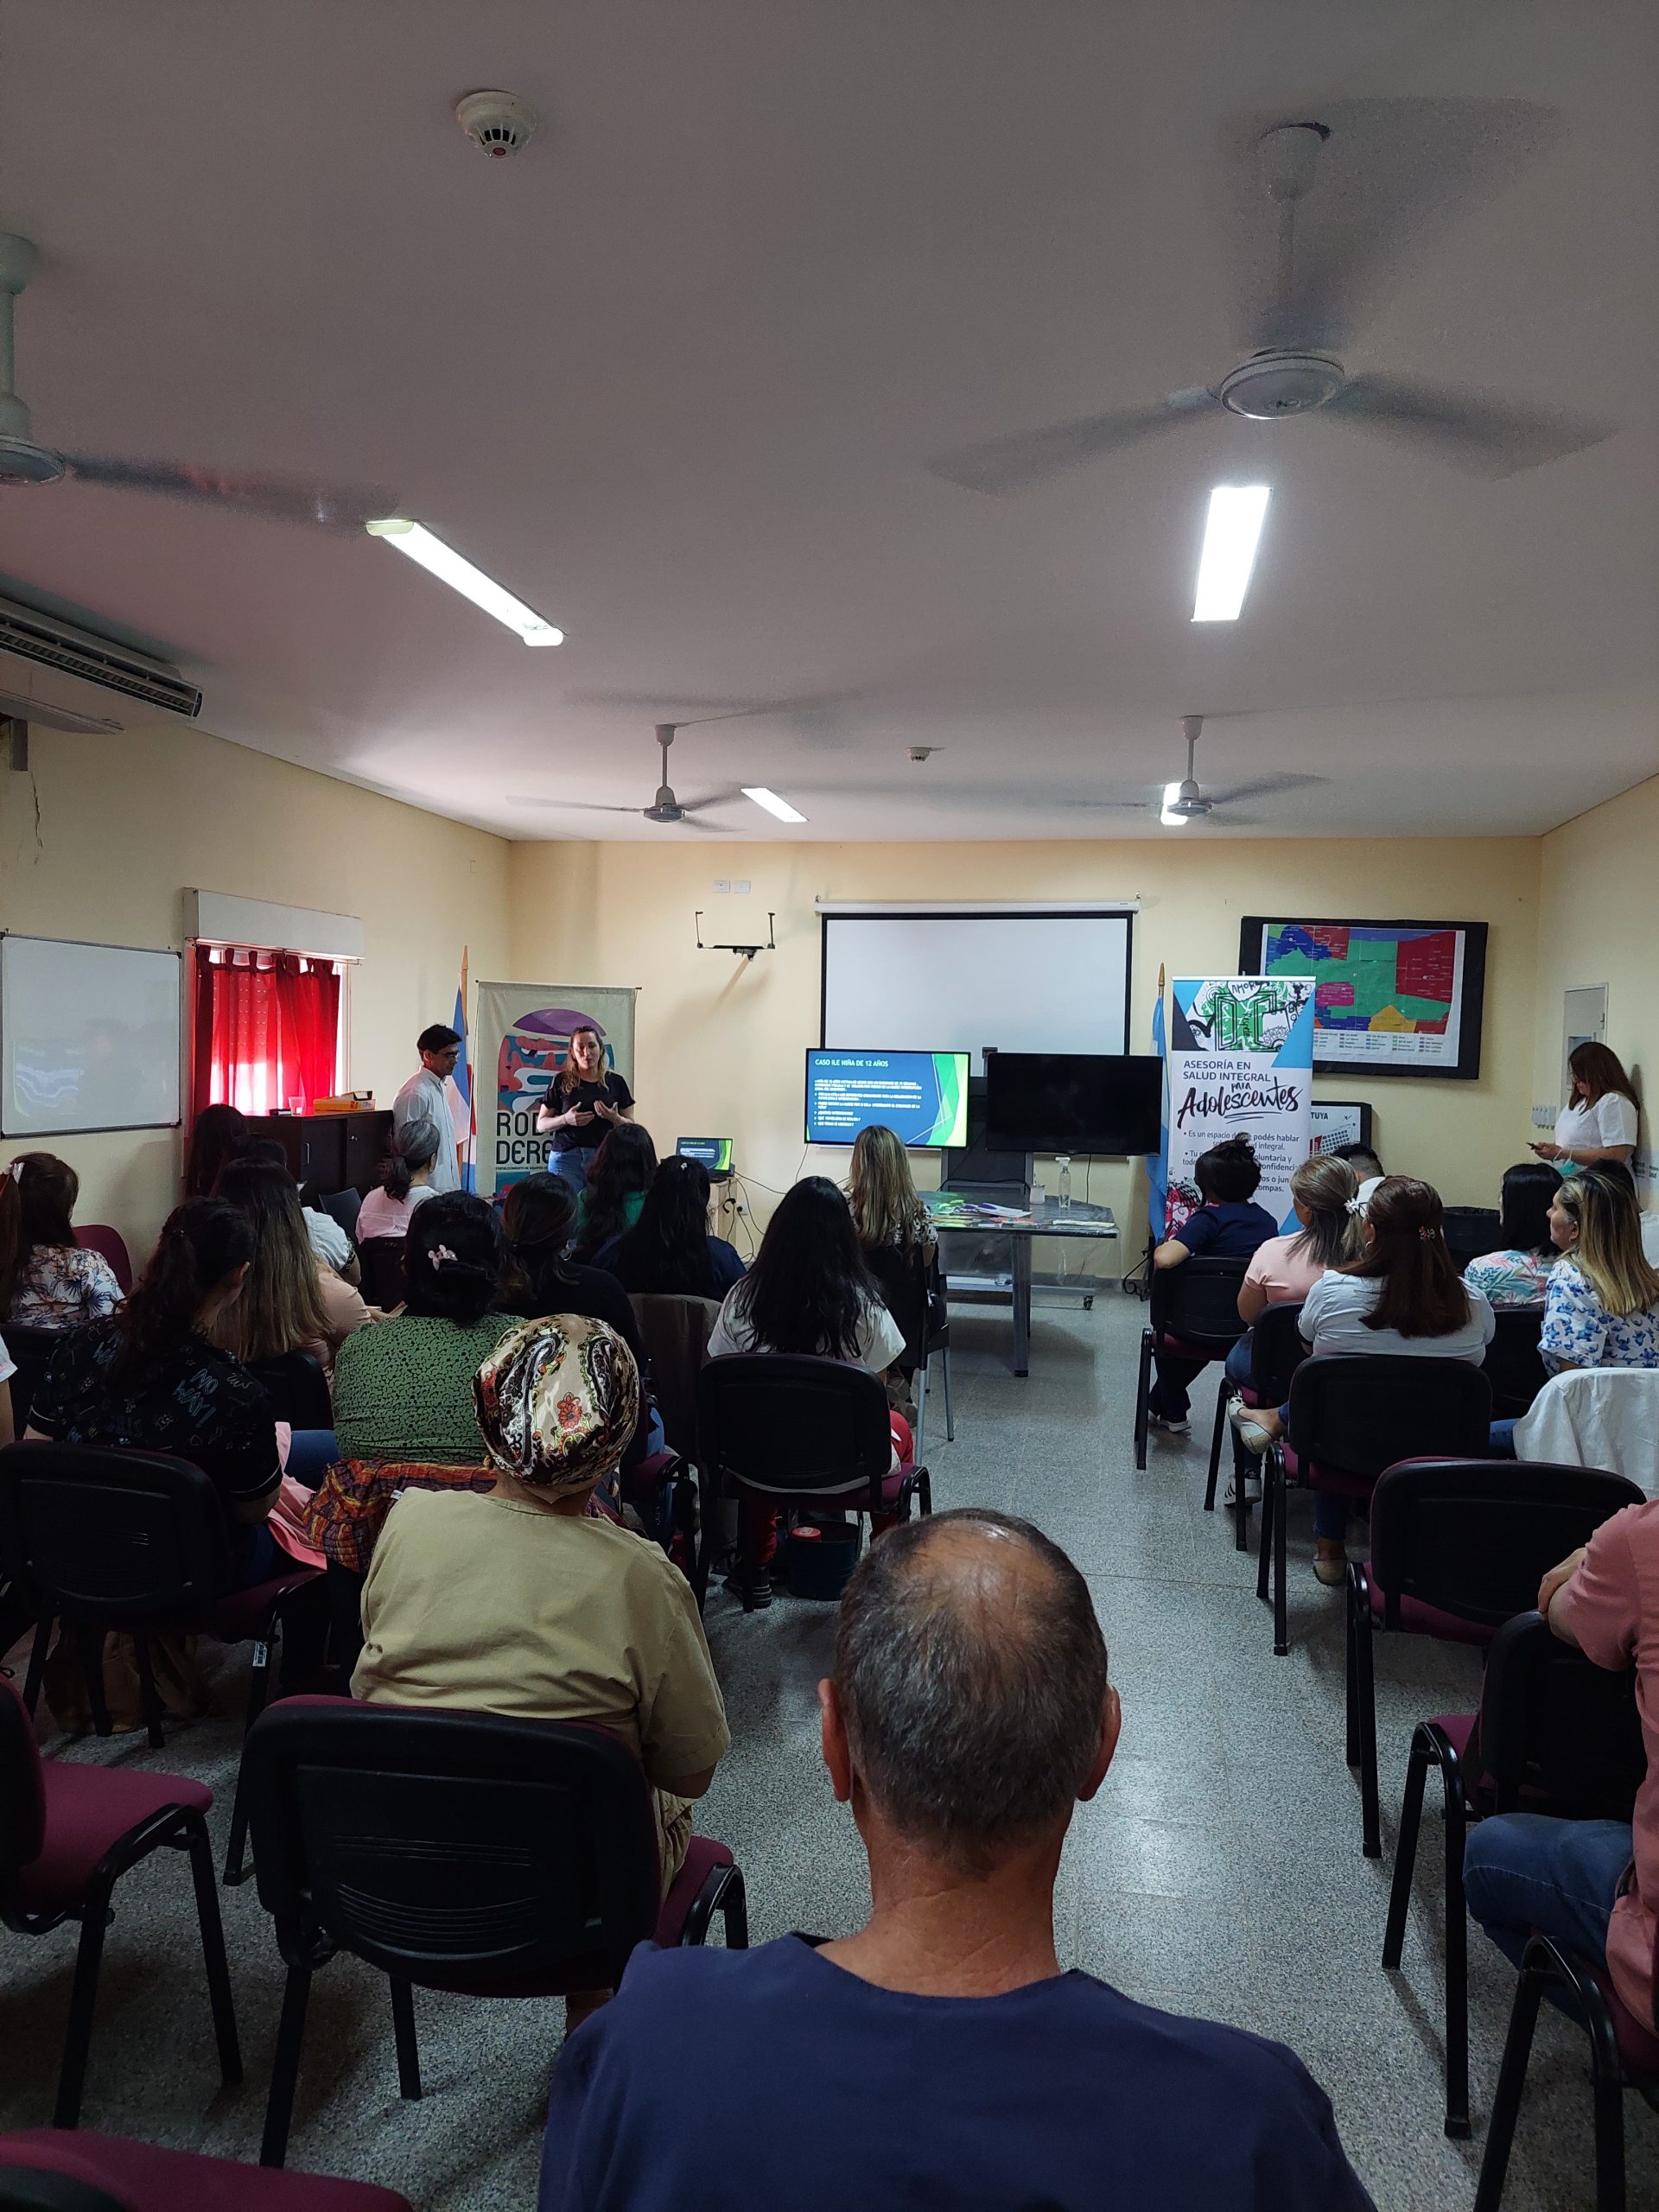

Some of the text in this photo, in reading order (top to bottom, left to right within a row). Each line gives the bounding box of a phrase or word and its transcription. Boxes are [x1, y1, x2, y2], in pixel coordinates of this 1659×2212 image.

[1184, 1059, 1251, 1070] ASESORÍA EN
[1183, 1071, 1271, 1082] SALUD INTEGRAL
[1177, 1077, 1303, 1129] Adolescentes
[497, 1112, 553, 1136] ROD
[1207, 1131, 1230, 1140] espacio
[1276, 1134, 1300, 1142] hablar
[1258, 1142, 1285, 1152] integral.
